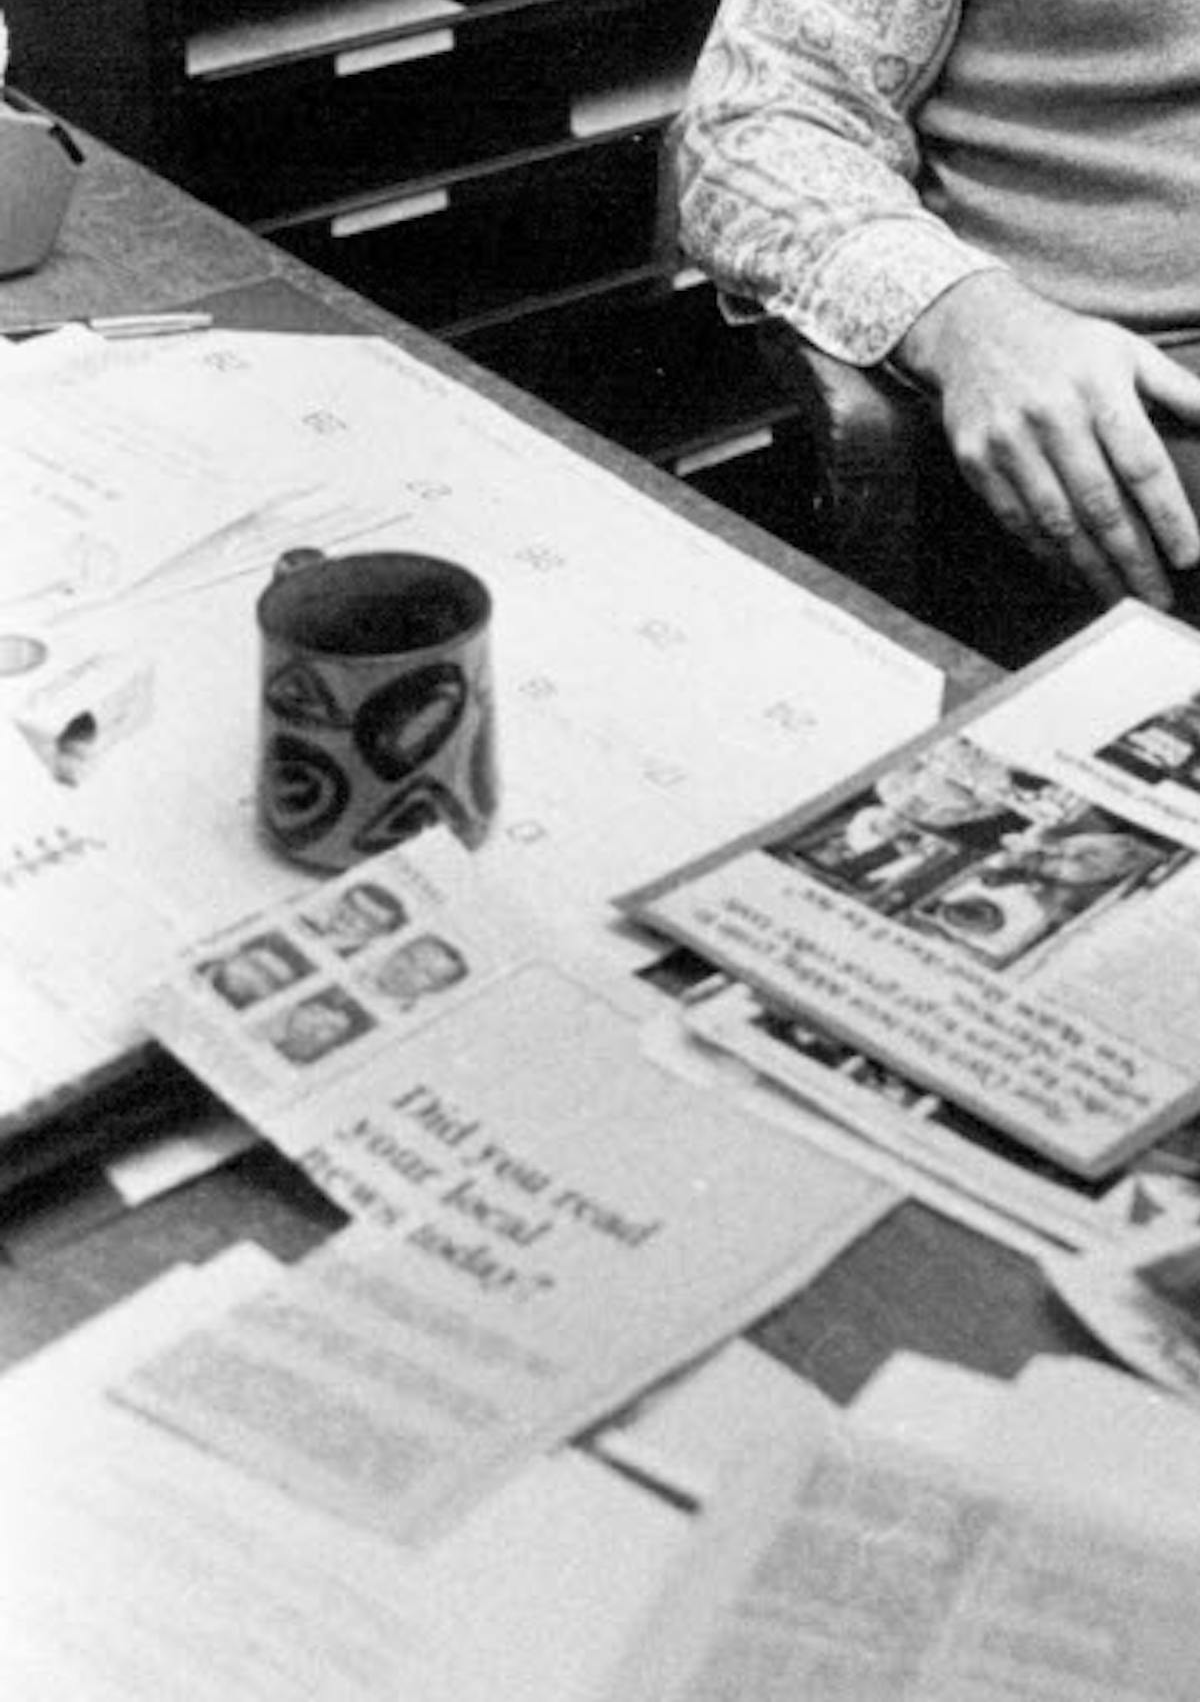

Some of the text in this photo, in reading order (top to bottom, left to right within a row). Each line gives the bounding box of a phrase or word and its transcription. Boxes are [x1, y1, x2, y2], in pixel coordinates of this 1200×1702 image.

[301, 1145, 556, 1300] news today?
[333, 1116, 554, 1248] your local
[392, 1084, 664, 1248] Did you read
